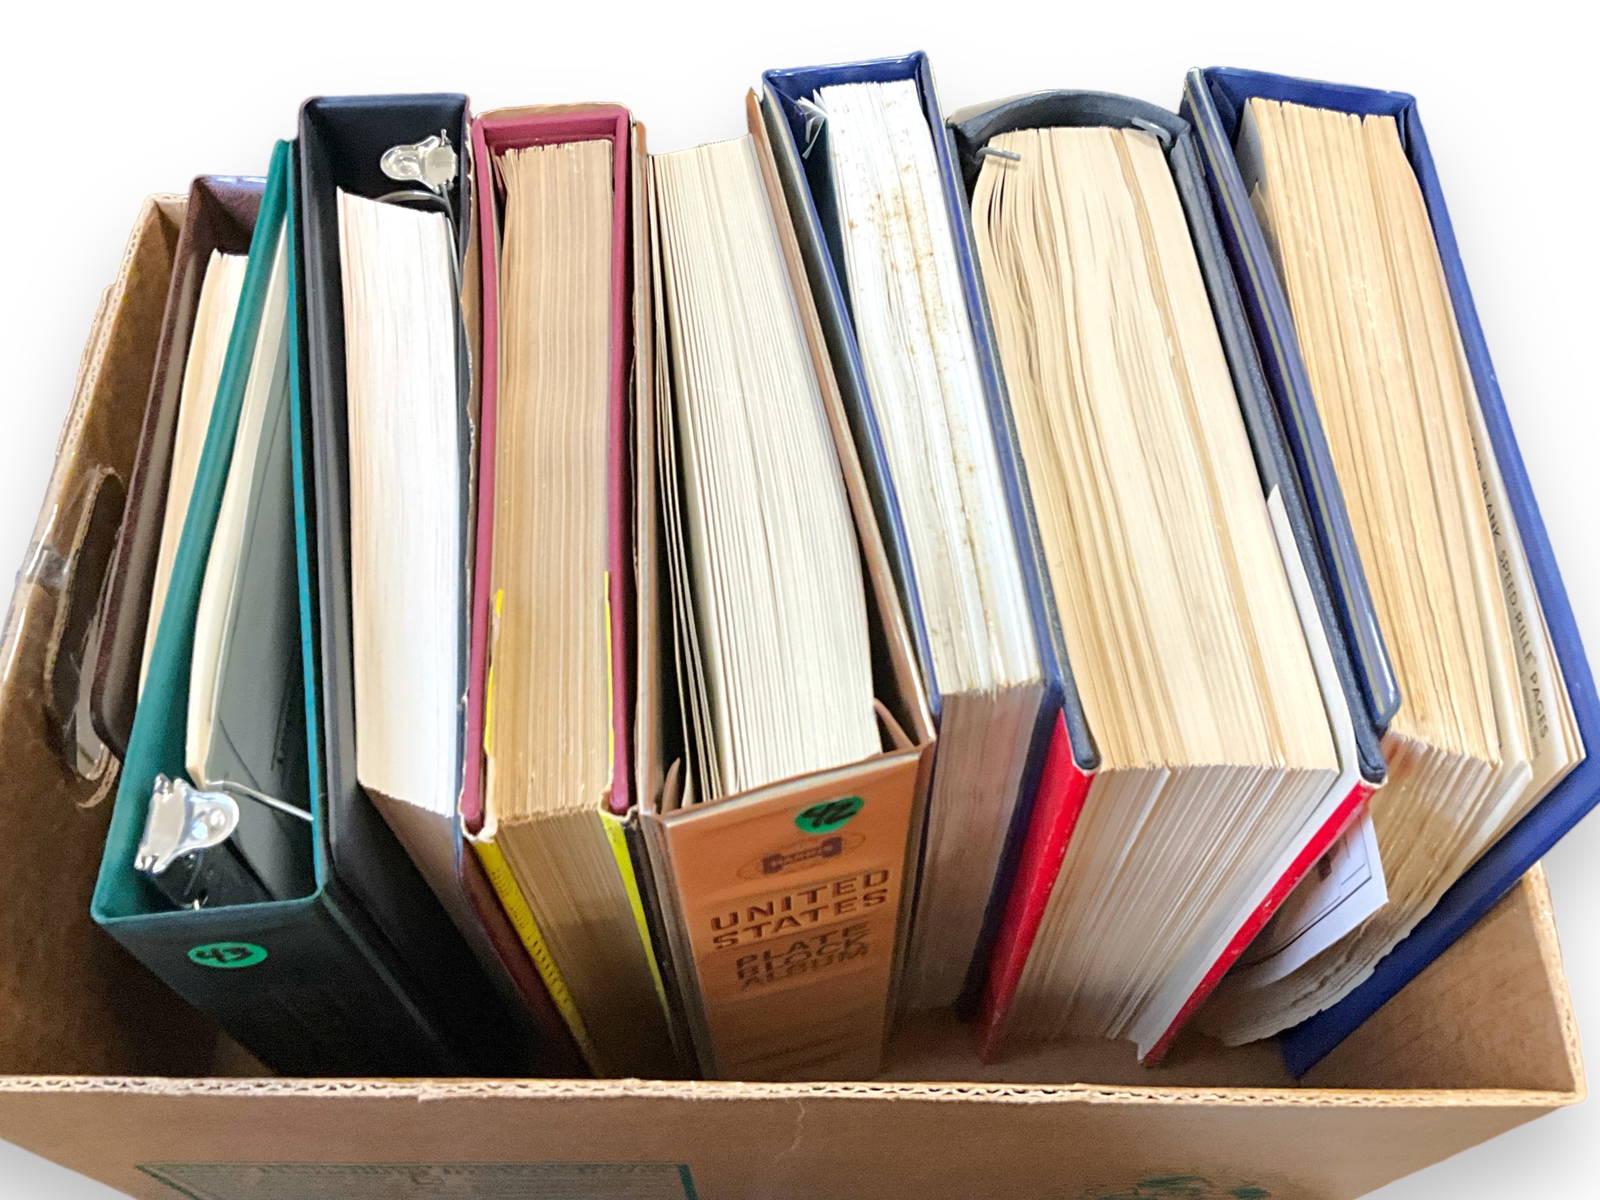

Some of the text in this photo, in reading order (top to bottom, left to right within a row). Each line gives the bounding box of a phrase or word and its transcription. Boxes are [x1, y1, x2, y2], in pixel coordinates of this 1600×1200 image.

[1530, 671, 1549, 738] PAGES
[711, 869, 889, 931] UNITED
[713, 888, 888, 949] STATES
[736, 920, 870, 969] PLATE
[737, 929, 872, 980] BLOCK
